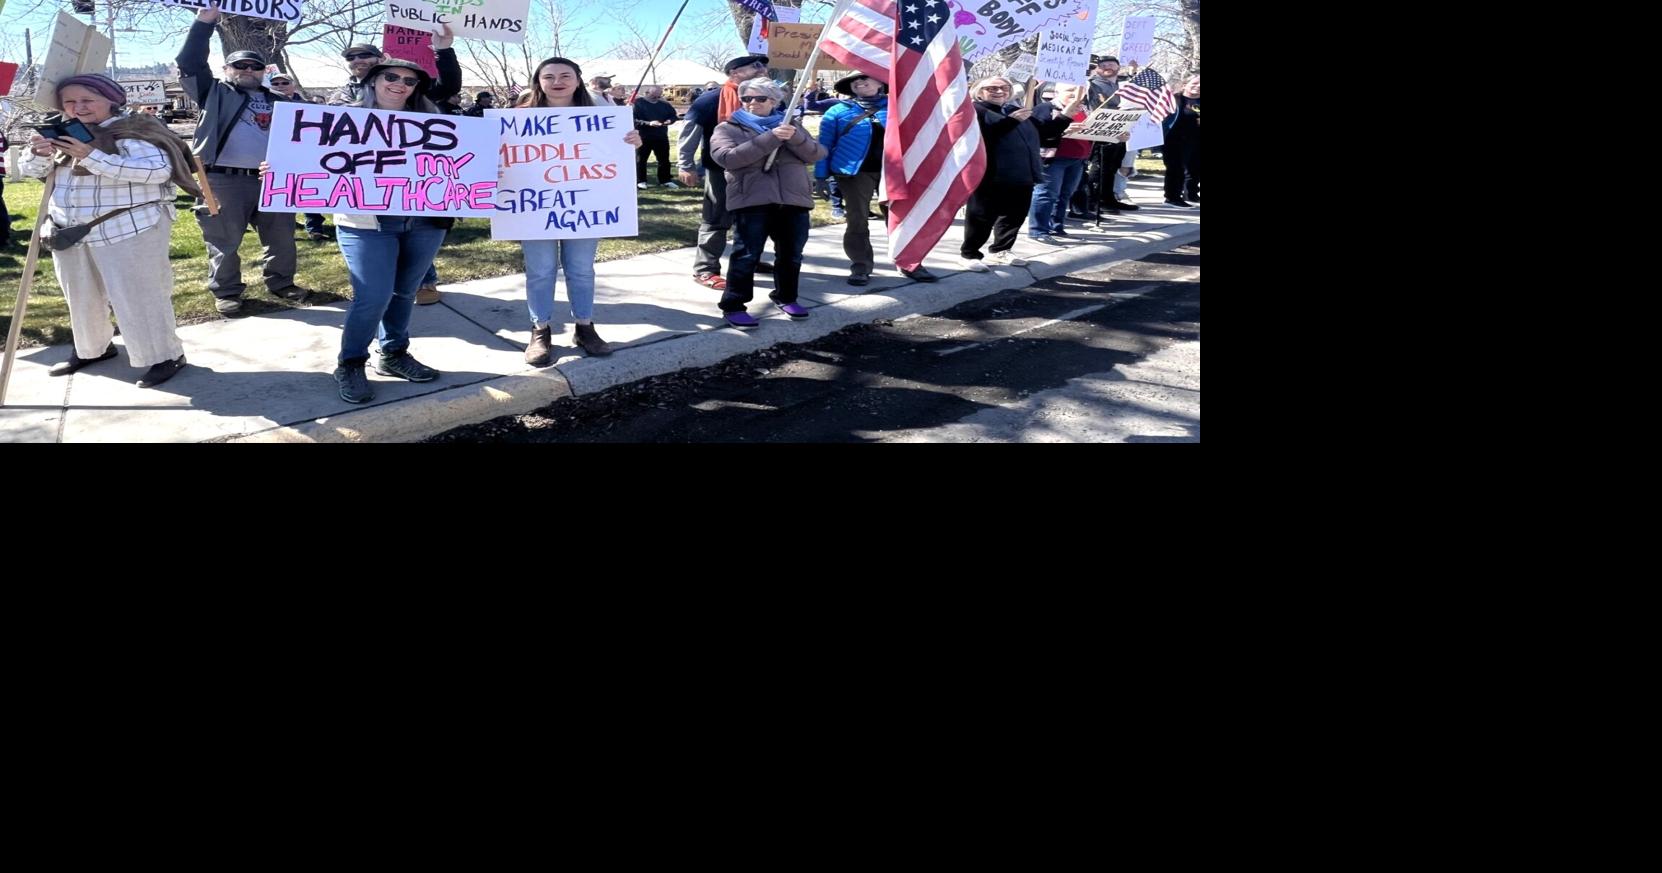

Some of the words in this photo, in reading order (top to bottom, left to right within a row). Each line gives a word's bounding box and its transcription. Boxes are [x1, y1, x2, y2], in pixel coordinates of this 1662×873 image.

[389, 4, 451, 24] PUBLIC
[463, 14, 522, 33] HANDS
[977, 0, 1025, 38] BODY
[397, 36, 422, 45] OFF
[1041, 41, 1083, 55] MEDICARE
[500, 114, 562, 137] MAKE
[568, 114, 616, 132] THE
[1090, 121, 1109, 130] WE
[1095, 112, 1112, 121] OH
[291, 109, 459, 151] HANDS
[319, 150, 407, 175] OFF
[543, 163, 617, 184] CLASS
[261, 171, 498, 212] HEALTHCARE
[496, 188, 591, 214] GREAT
[544, 206, 620, 232] AGAIN
